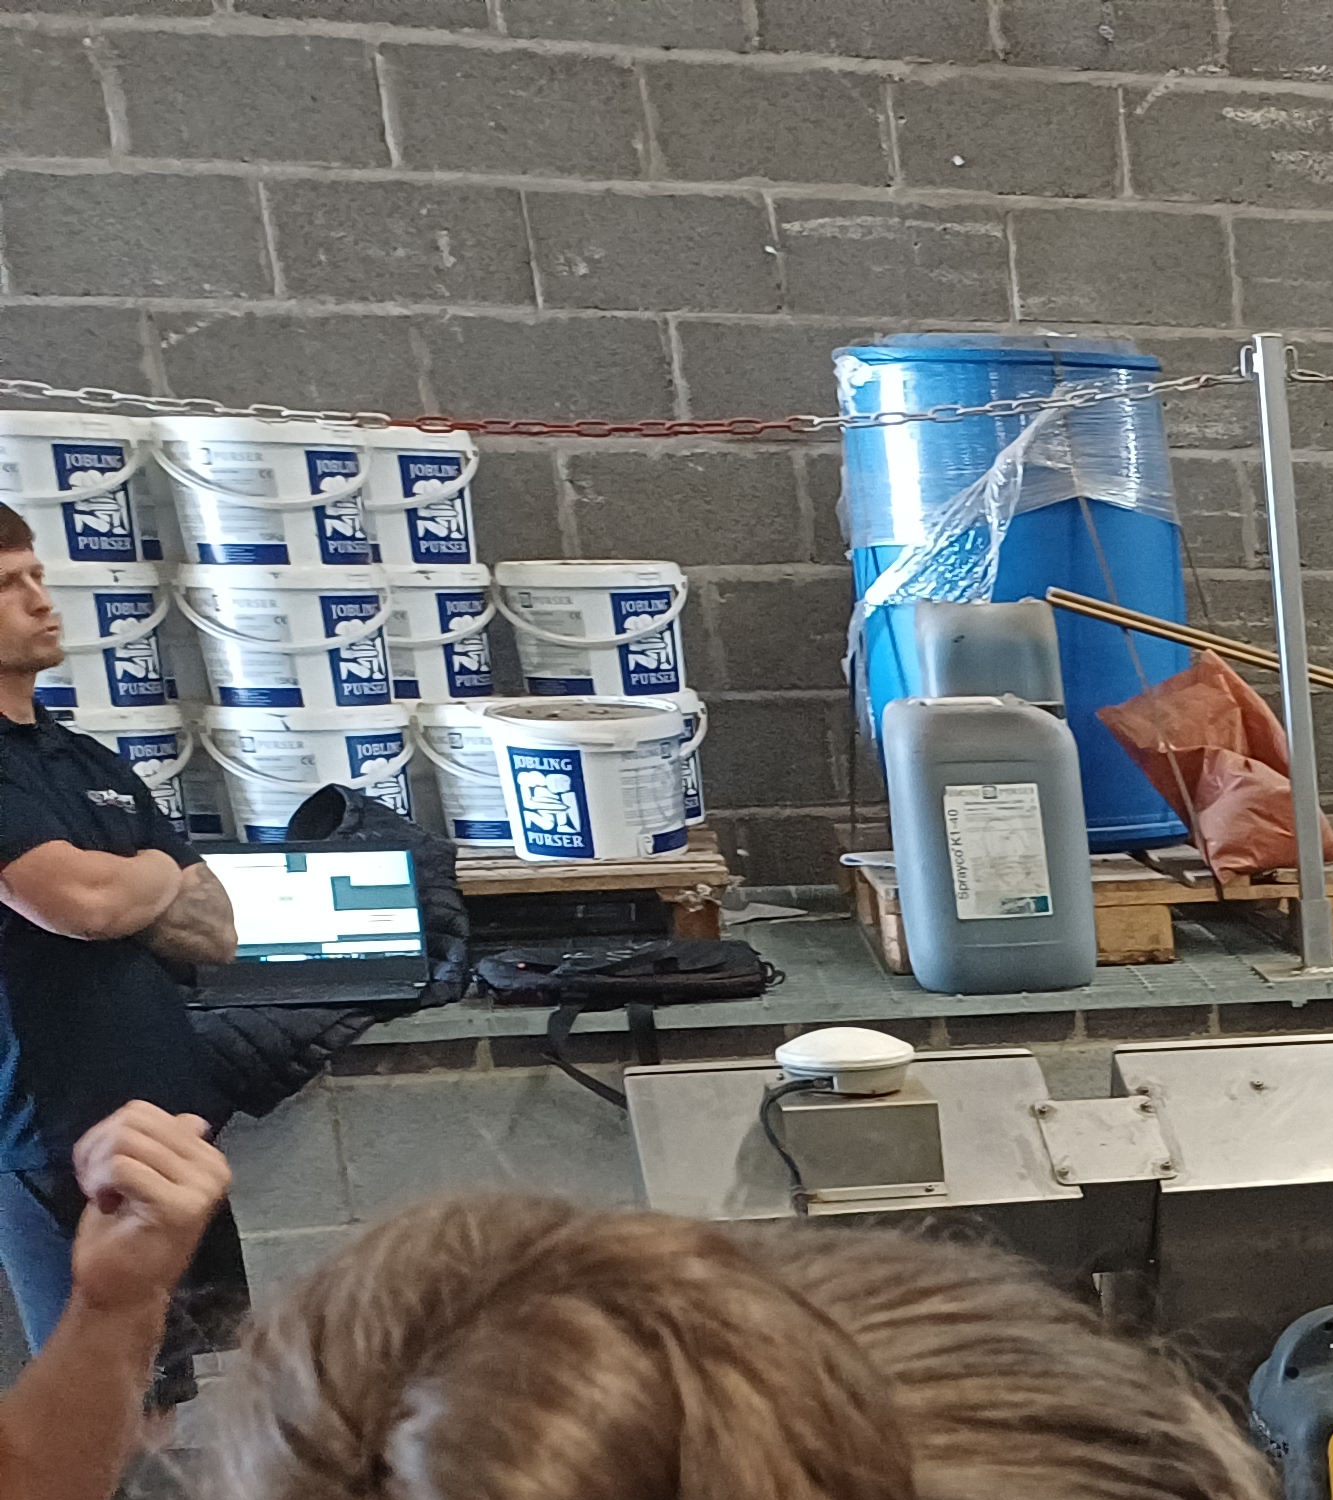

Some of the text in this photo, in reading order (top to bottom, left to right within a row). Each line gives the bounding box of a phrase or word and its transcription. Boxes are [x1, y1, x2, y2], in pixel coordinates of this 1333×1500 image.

[78, 536, 133, 550] PURSER
[420, 540, 468, 553] PURSER
[630, 671, 677, 685] PURSER
[513, 754, 573, 771] JOBLING
[528, 831, 585, 849] PURSER
